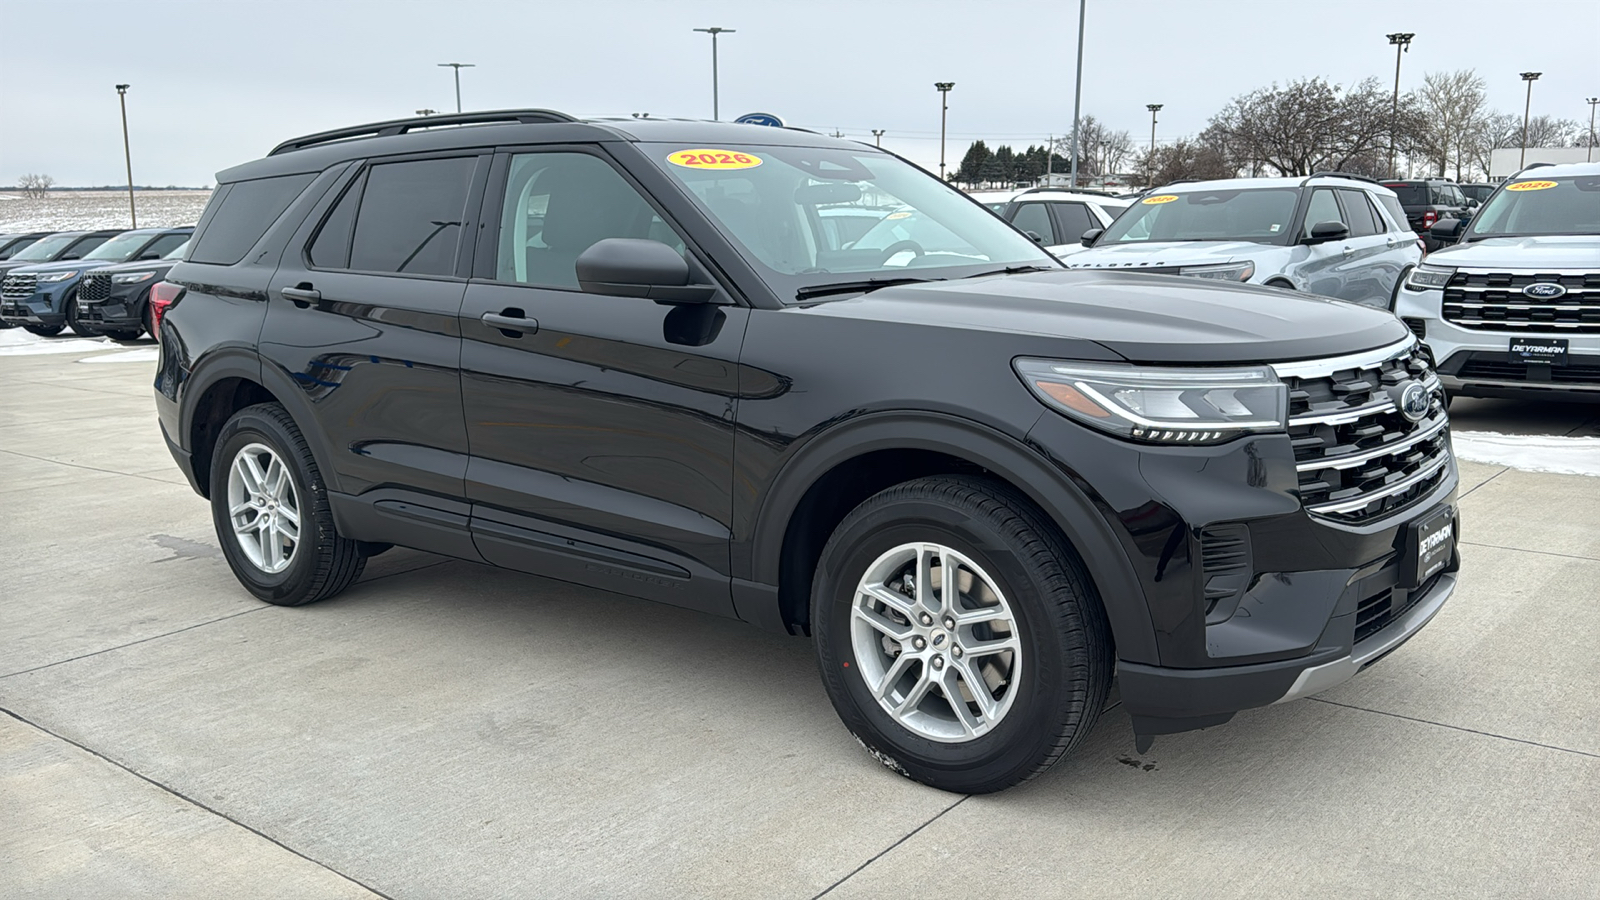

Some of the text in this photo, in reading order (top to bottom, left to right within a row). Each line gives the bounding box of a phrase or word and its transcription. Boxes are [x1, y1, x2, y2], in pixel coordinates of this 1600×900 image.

[680, 153, 753, 165] 2026
[1532, 286, 1556, 295] Ford
[1511, 345, 1566, 354] DEYARMAN
